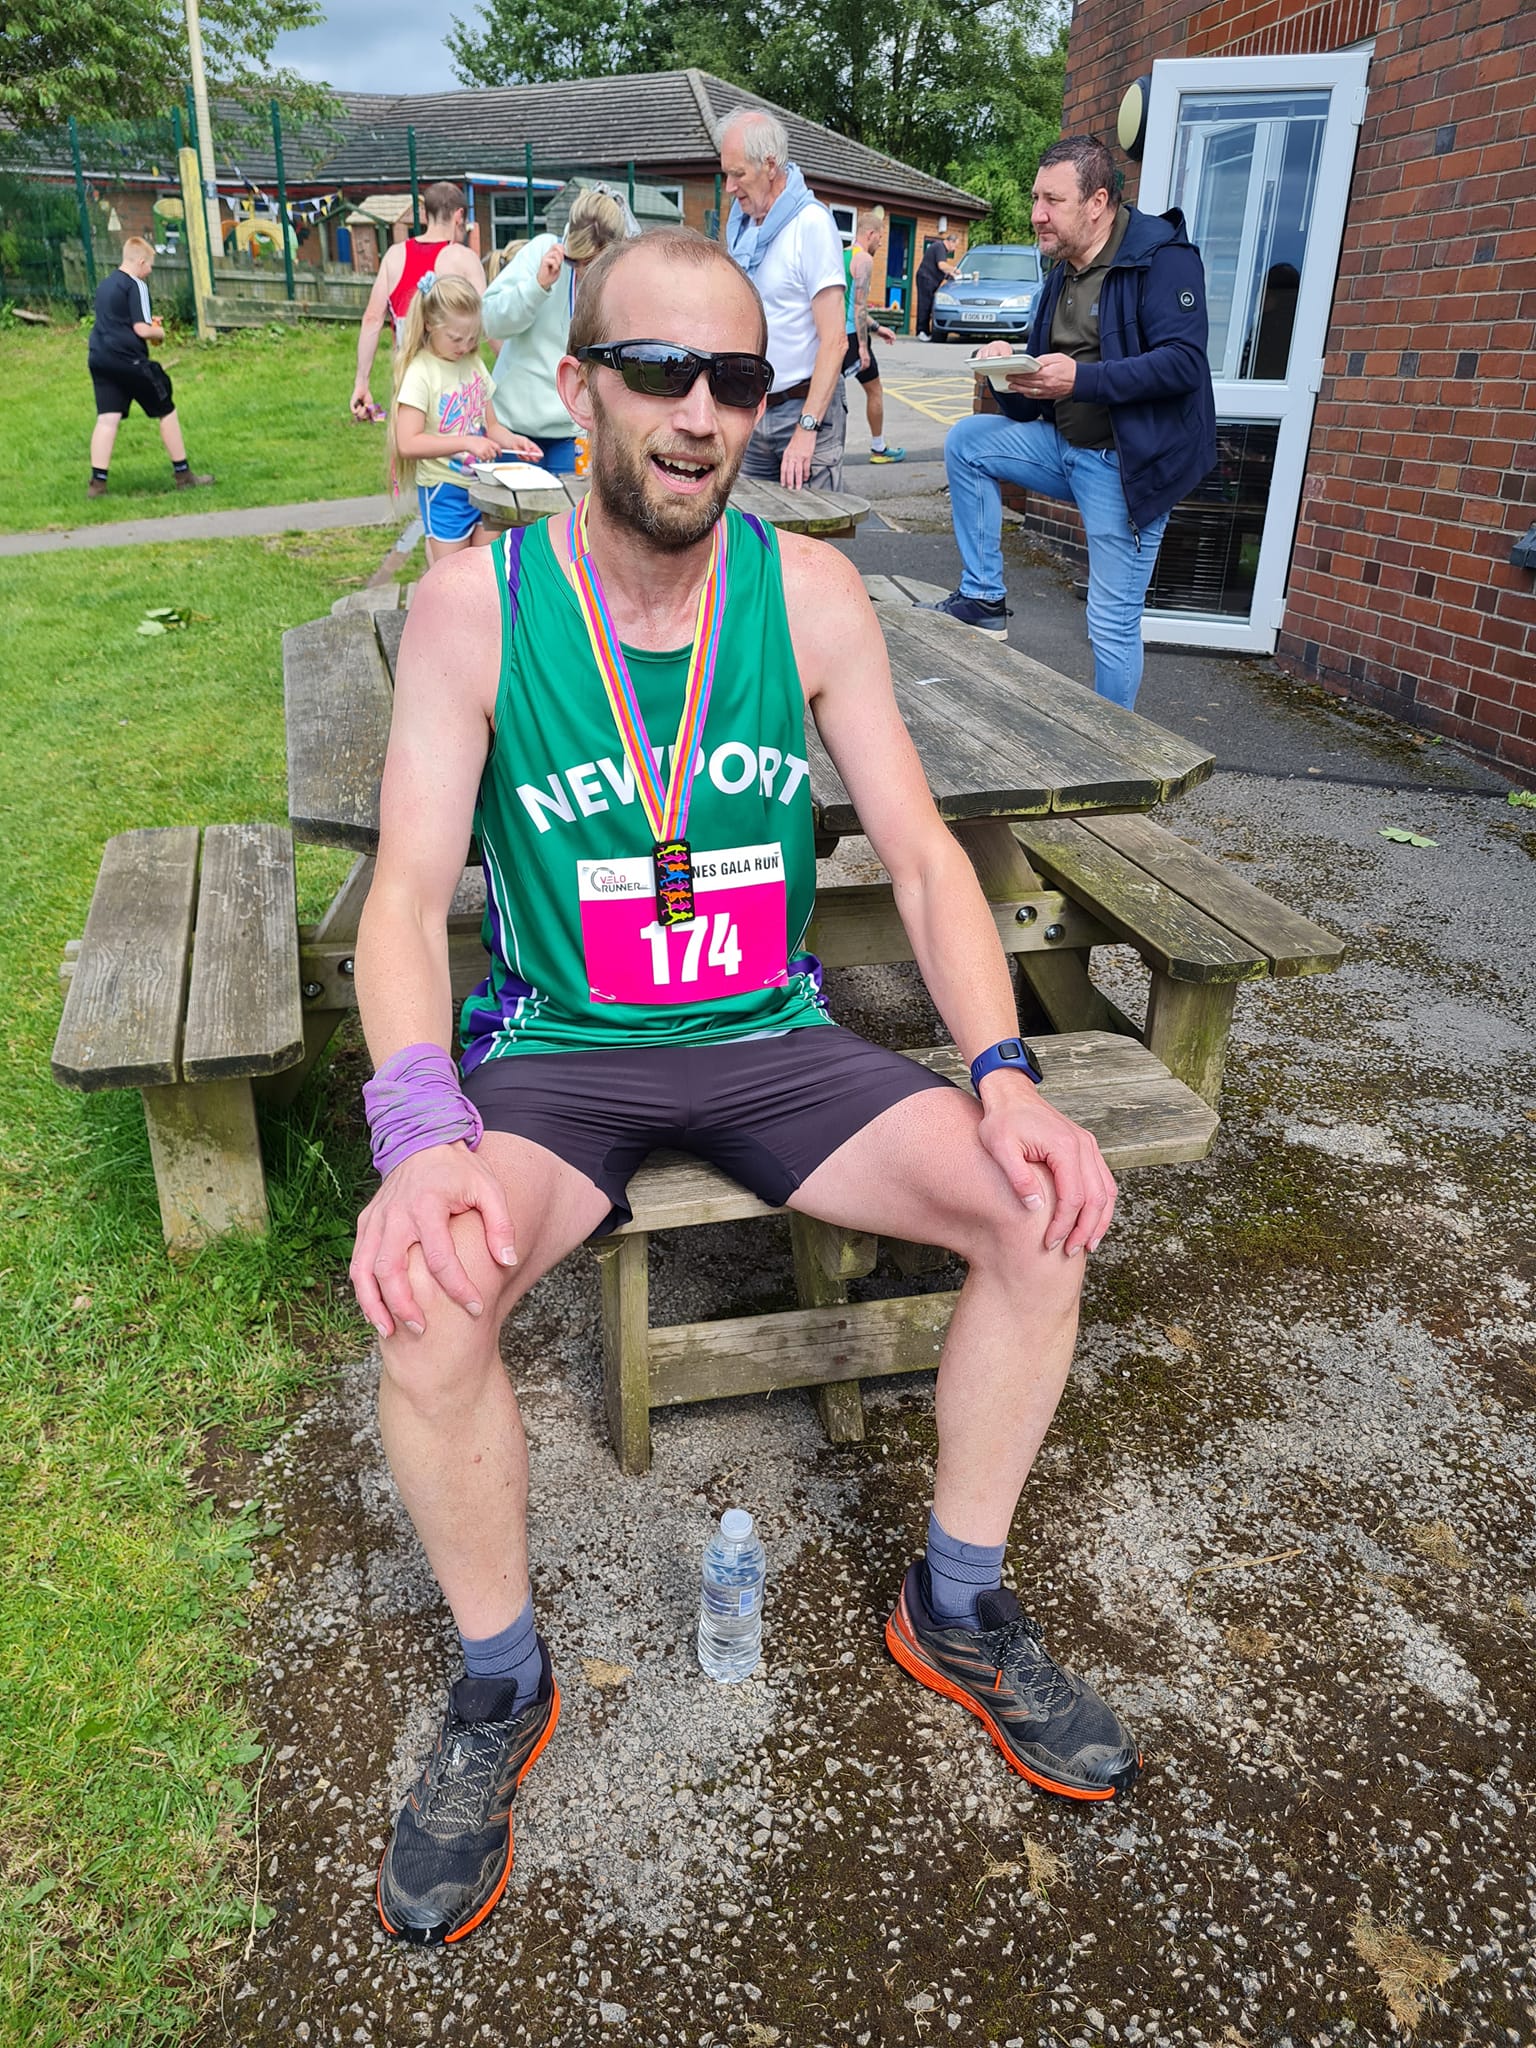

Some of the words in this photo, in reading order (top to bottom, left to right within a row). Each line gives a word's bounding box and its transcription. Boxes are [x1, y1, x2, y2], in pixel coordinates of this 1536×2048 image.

[720, 858, 752, 876] GALA
[754, 855, 780, 871] RUN
[600, 874, 627, 884] VELO
[601, 882, 641, 893] RUNNER
[640, 912, 742, 985] 174
